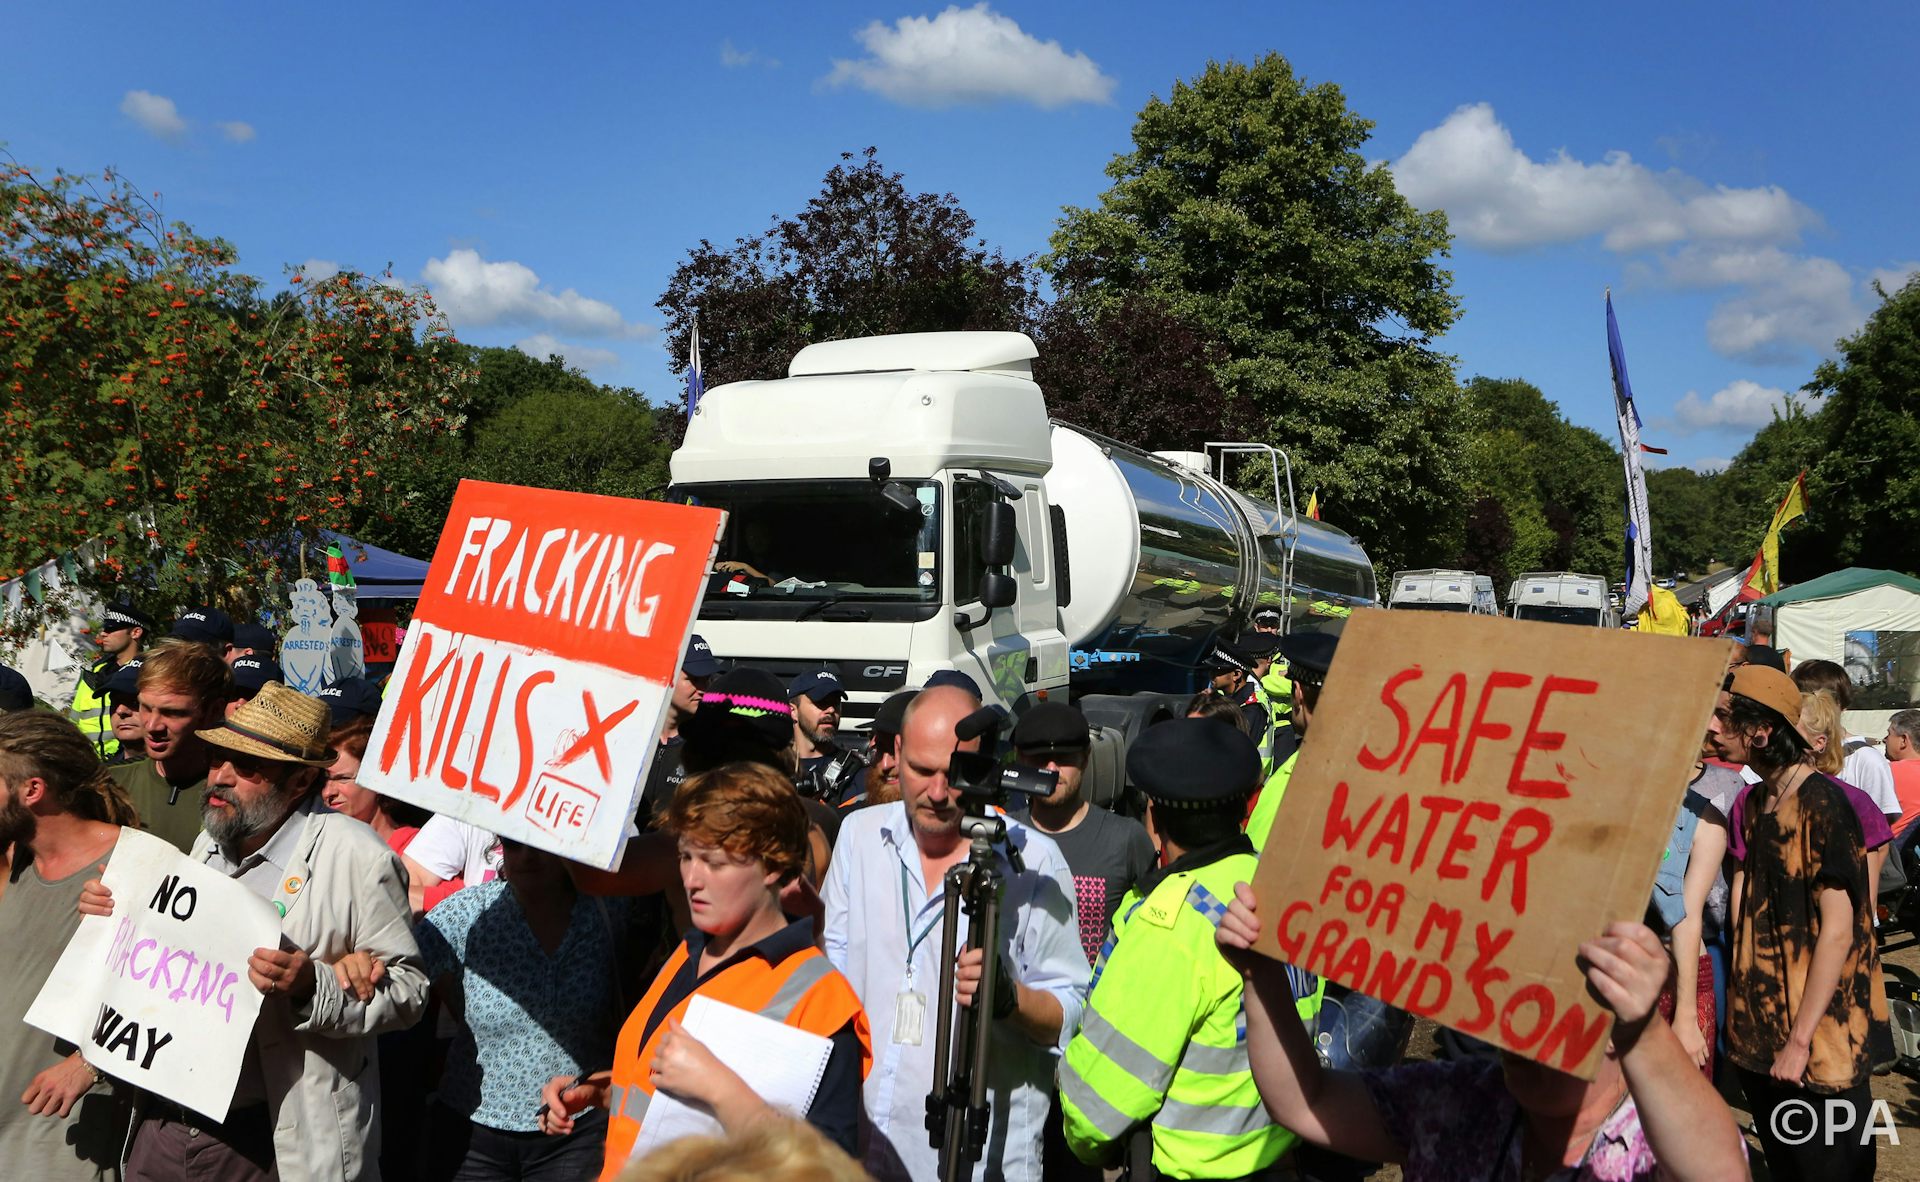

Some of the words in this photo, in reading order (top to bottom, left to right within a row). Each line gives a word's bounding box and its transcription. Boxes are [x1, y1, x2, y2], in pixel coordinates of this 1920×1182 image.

[444, 516, 676, 638] FRACKING
[234, 660, 260, 669] POLICE
[284, 640, 325, 651] ARRESTED
[330, 637, 362, 649] ARRESTED
[862, 665, 904, 678] CF
[379, 632, 555, 813] KILLS
[1357, 664, 1599, 799] SAFE
[535, 785, 585, 828] LIFE
[1321, 782, 1554, 916] WATER
[149, 874, 197, 921] NO
[1319, 865, 1405, 934] FOR
[1415, 902, 1513, 985] MY
[92, 1002, 173, 1070] WAY
